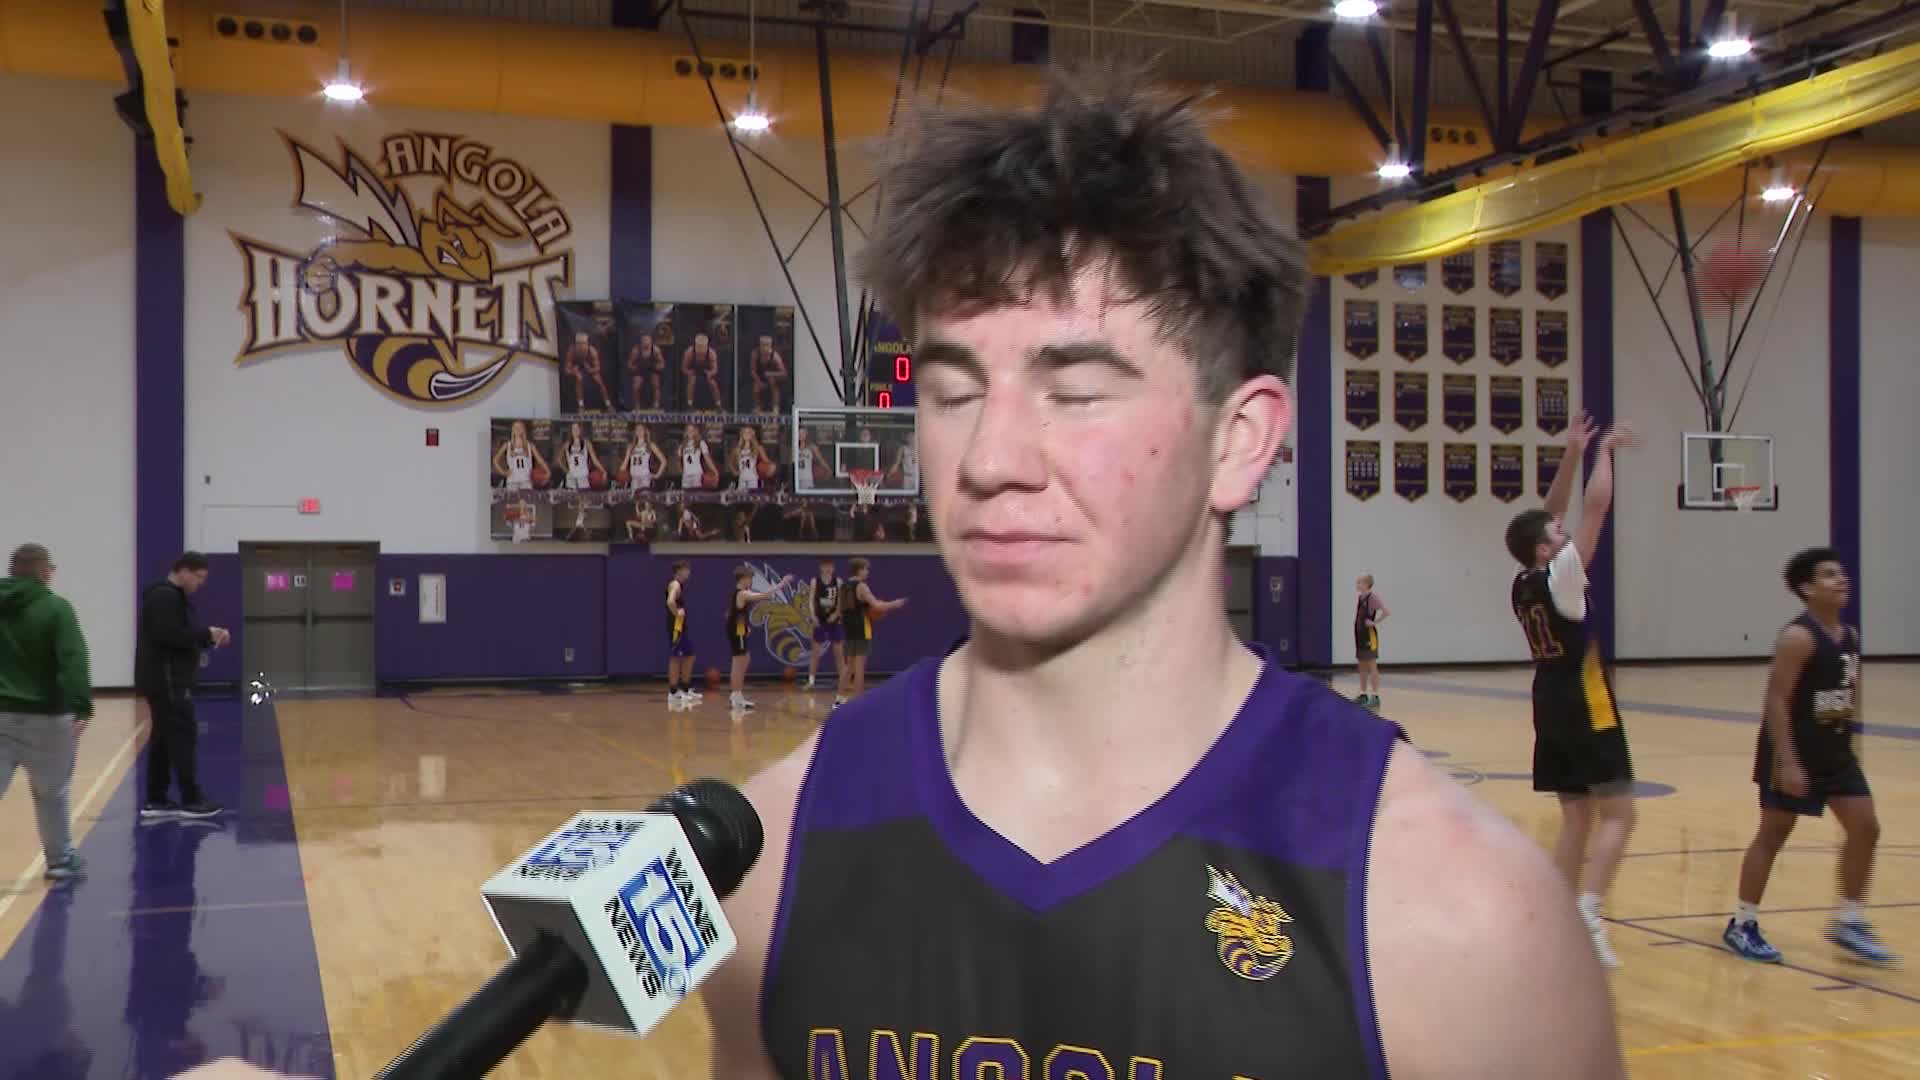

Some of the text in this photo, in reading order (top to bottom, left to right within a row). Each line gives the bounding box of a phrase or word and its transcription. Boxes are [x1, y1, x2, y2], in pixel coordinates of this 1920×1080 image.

[385, 133, 570, 251] ANGOLA
[249, 252, 569, 357] HORNETS
[896, 357, 909, 381] 0
[513, 864, 583, 881] NEWS
[534, 833, 629, 868] 15
[575, 818, 646, 833] WANE
[604, 896, 661, 998] NEWS
[630, 867, 701, 967] 15
[665, 848, 719, 948] WANE
